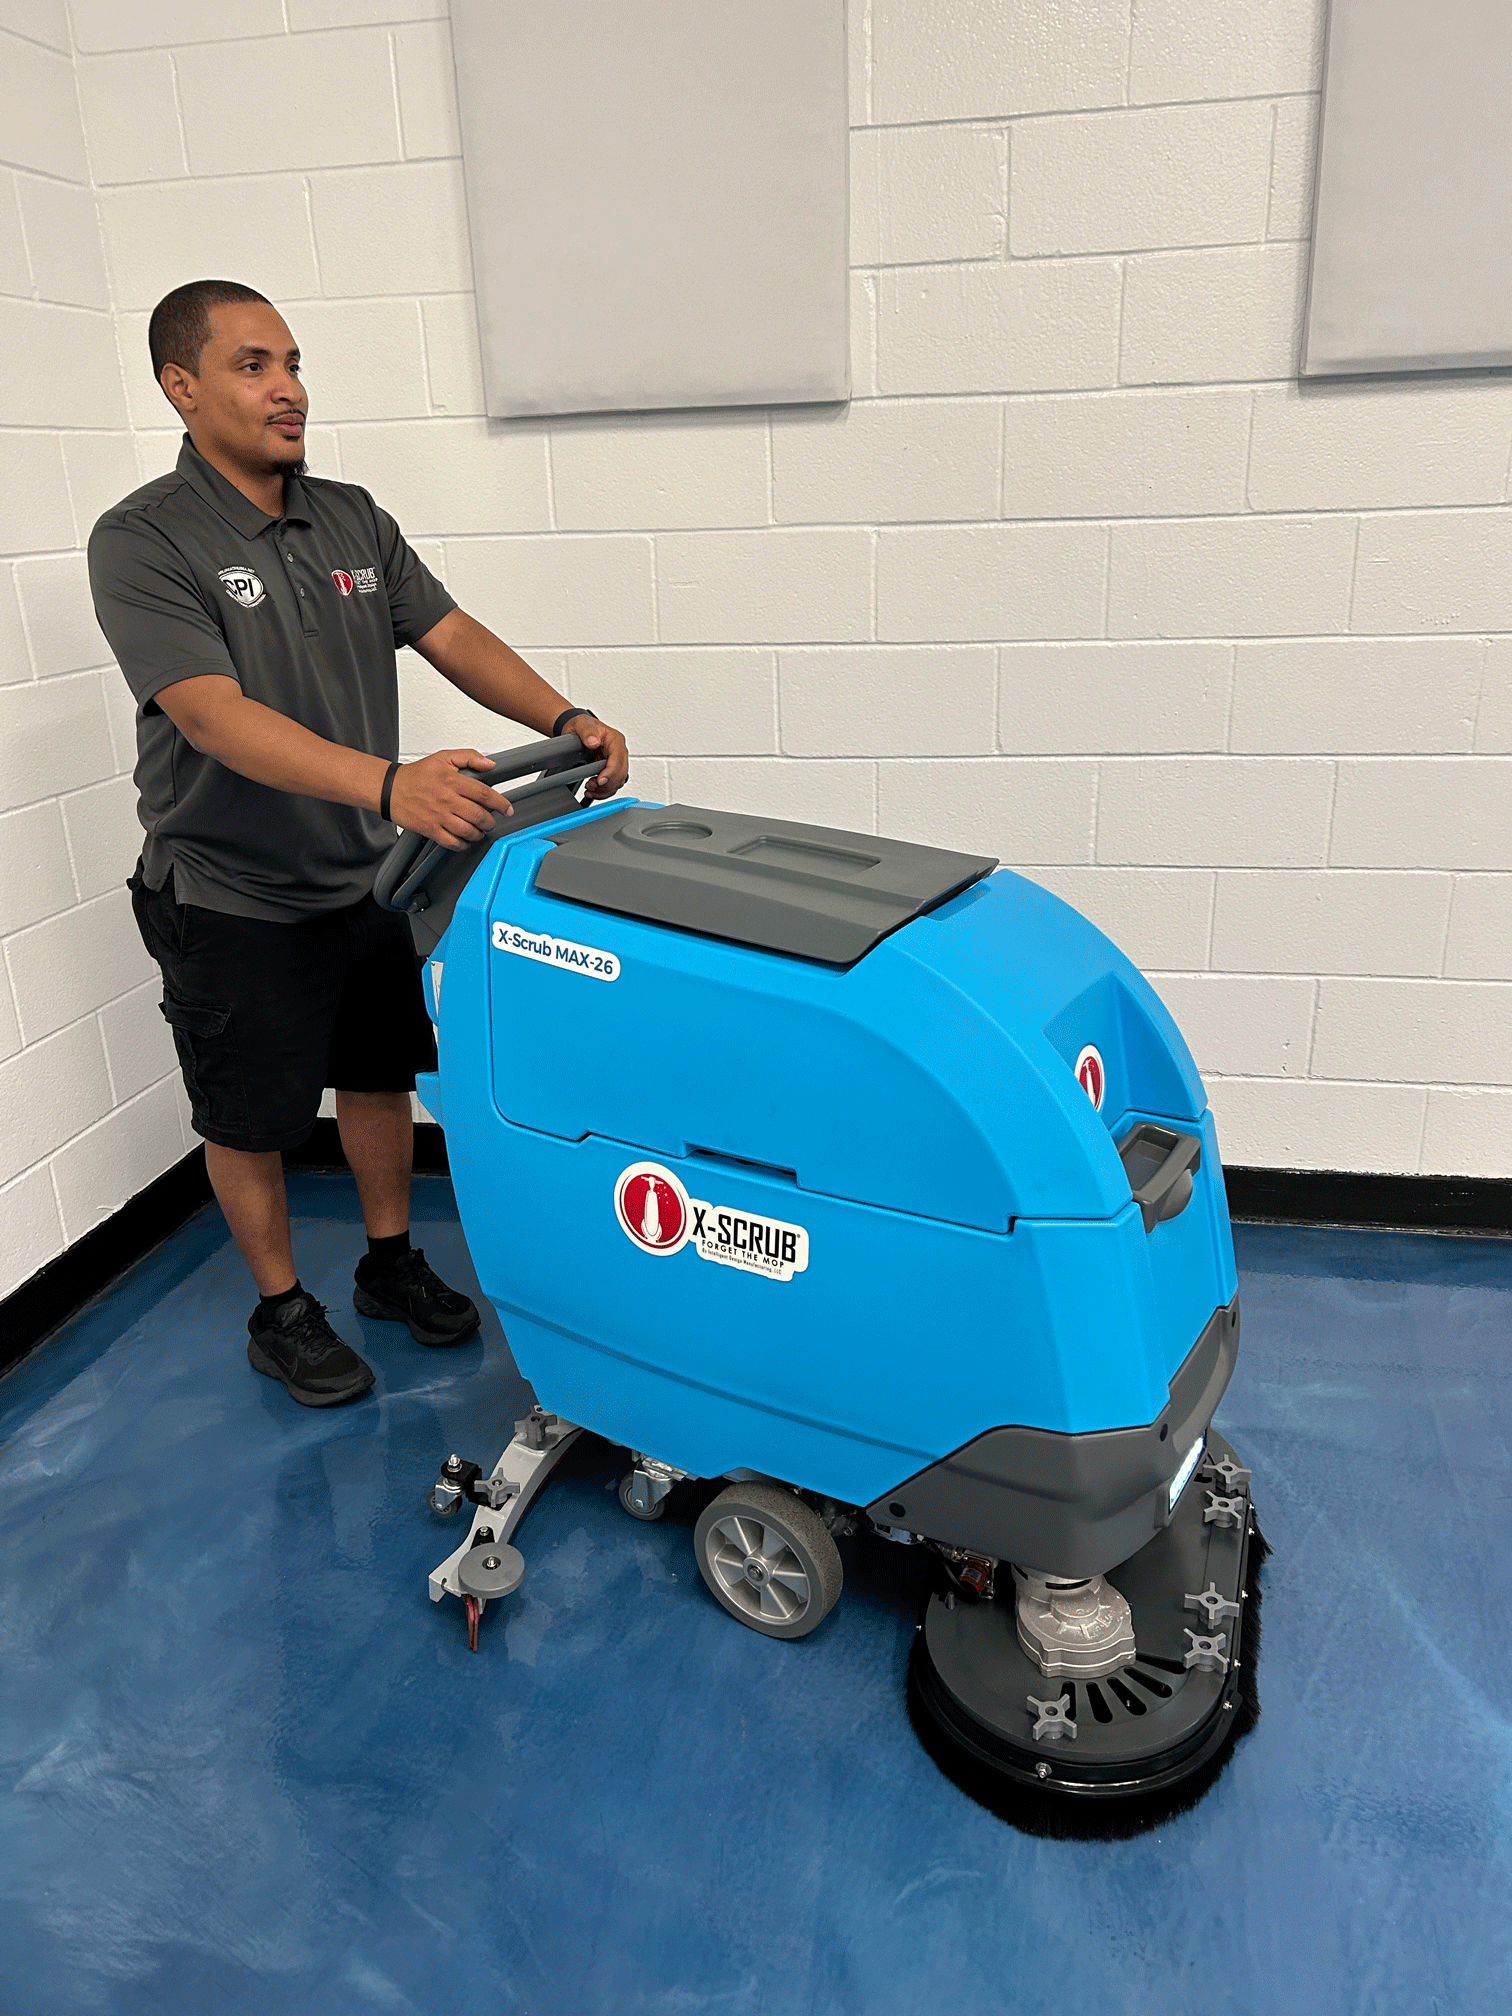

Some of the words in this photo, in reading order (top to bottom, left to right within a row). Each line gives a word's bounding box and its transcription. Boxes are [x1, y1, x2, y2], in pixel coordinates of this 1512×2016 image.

[498, 928, 552, 957] X-Scrub
[555, 945, 613, 975] MAX-26
[692, 1206, 797, 1263] X-SCRUB
[702, 1239, 738, 1256] FORGET
[742, 1250, 758, 1262] THE
[763, 1256, 785, 1268] MOP
